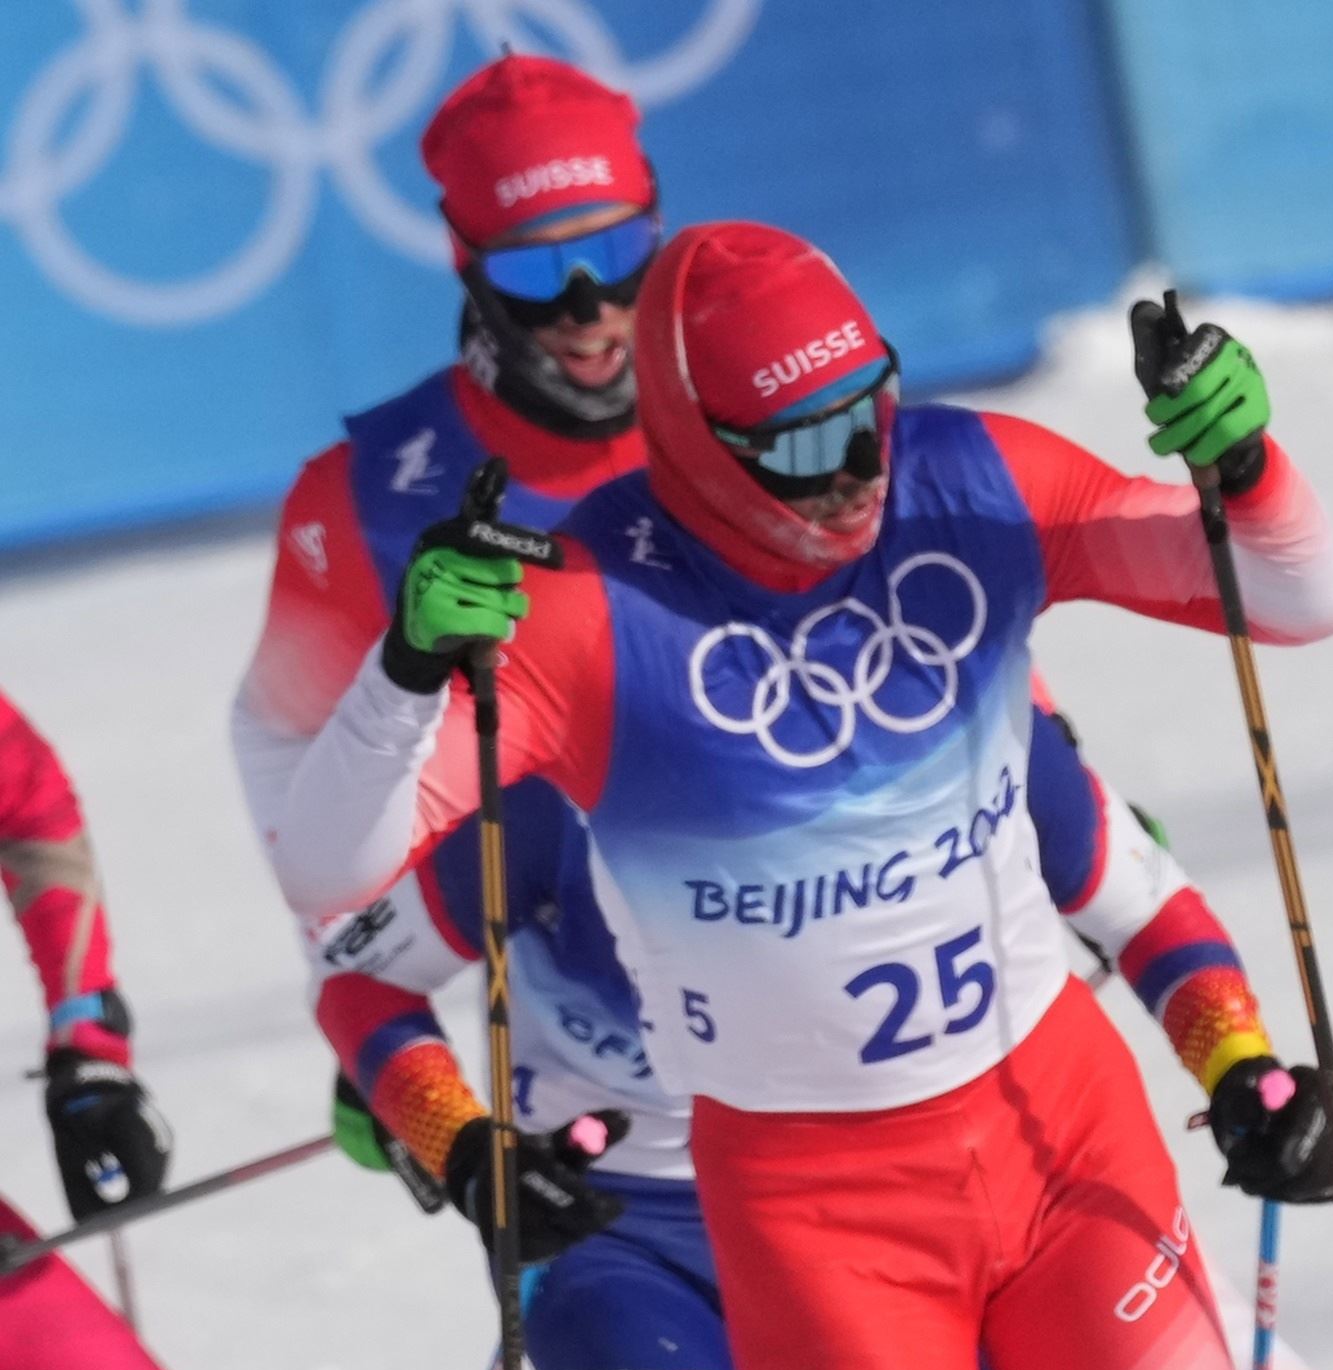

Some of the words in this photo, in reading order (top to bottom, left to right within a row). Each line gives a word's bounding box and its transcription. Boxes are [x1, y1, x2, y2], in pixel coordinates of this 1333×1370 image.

[495, 156, 614, 208] SUISSE
[752, 320, 866, 398] SUISSE
[684, 850, 918, 939] BEIJING
[680, 986, 717, 1045] 5
[844, 924, 998, 1066] 25
